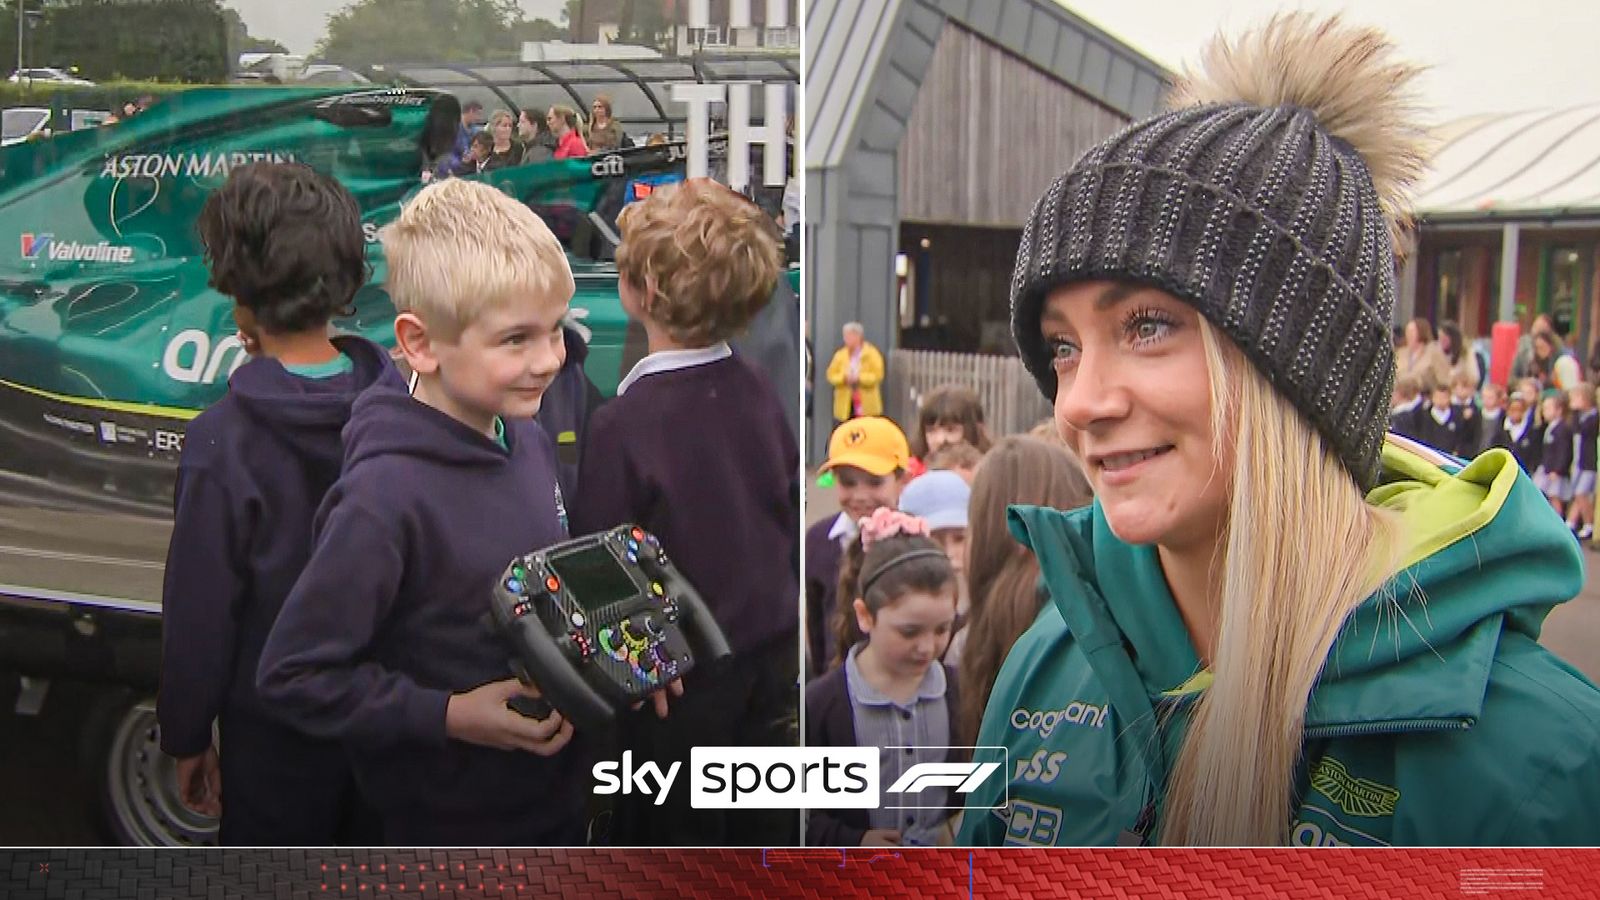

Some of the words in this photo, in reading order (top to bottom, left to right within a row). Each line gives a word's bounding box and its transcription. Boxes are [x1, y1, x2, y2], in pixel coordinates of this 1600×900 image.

[671, 83, 796, 188] TH
[101, 153, 184, 178] ASTON
[592, 154, 625, 175] citi
[49, 241, 134, 263] Valvoline
[155, 431, 185, 452] ER
